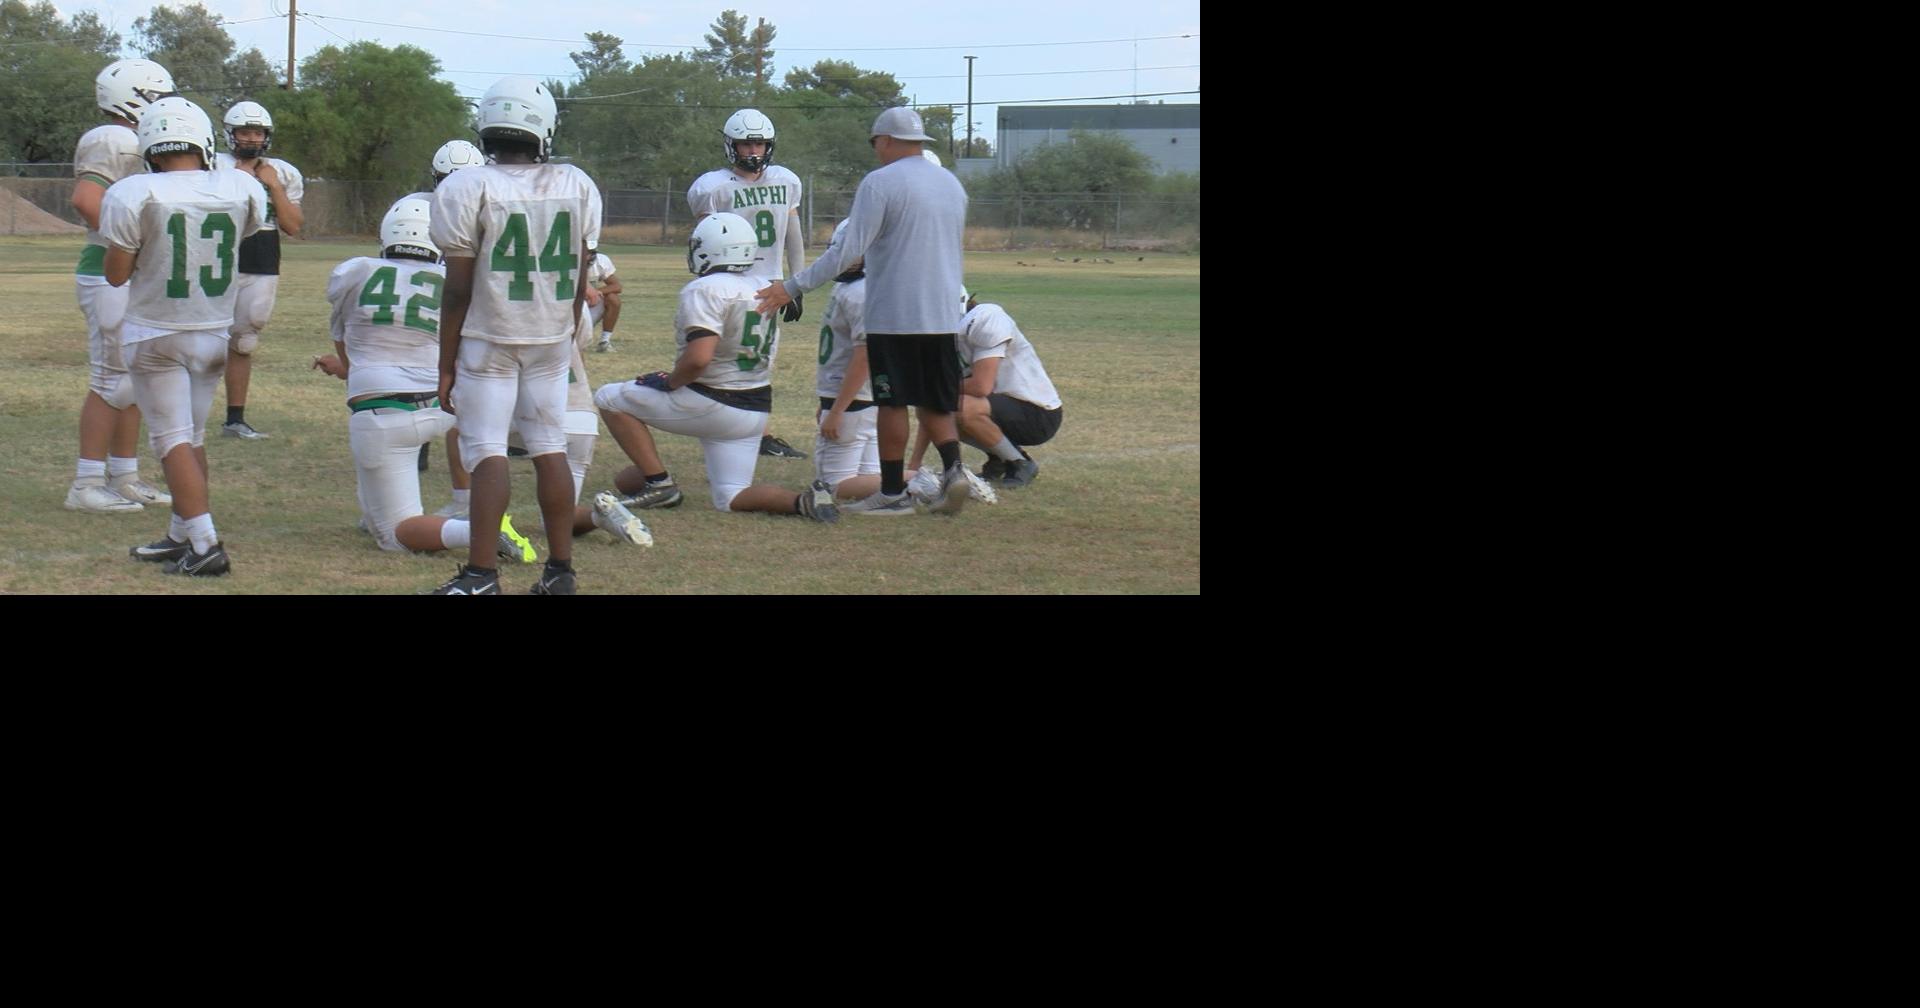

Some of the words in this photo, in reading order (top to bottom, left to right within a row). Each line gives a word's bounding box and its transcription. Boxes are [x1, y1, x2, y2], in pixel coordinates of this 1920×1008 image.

[150, 142, 188, 155] Riddell
[733, 185, 787, 209] AMPHI
[166, 212, 236, 299] 13
[491, 211, 578, 301] 44
[755, 210, 777, 248] 8
[358, 265, 444, 335] 42
